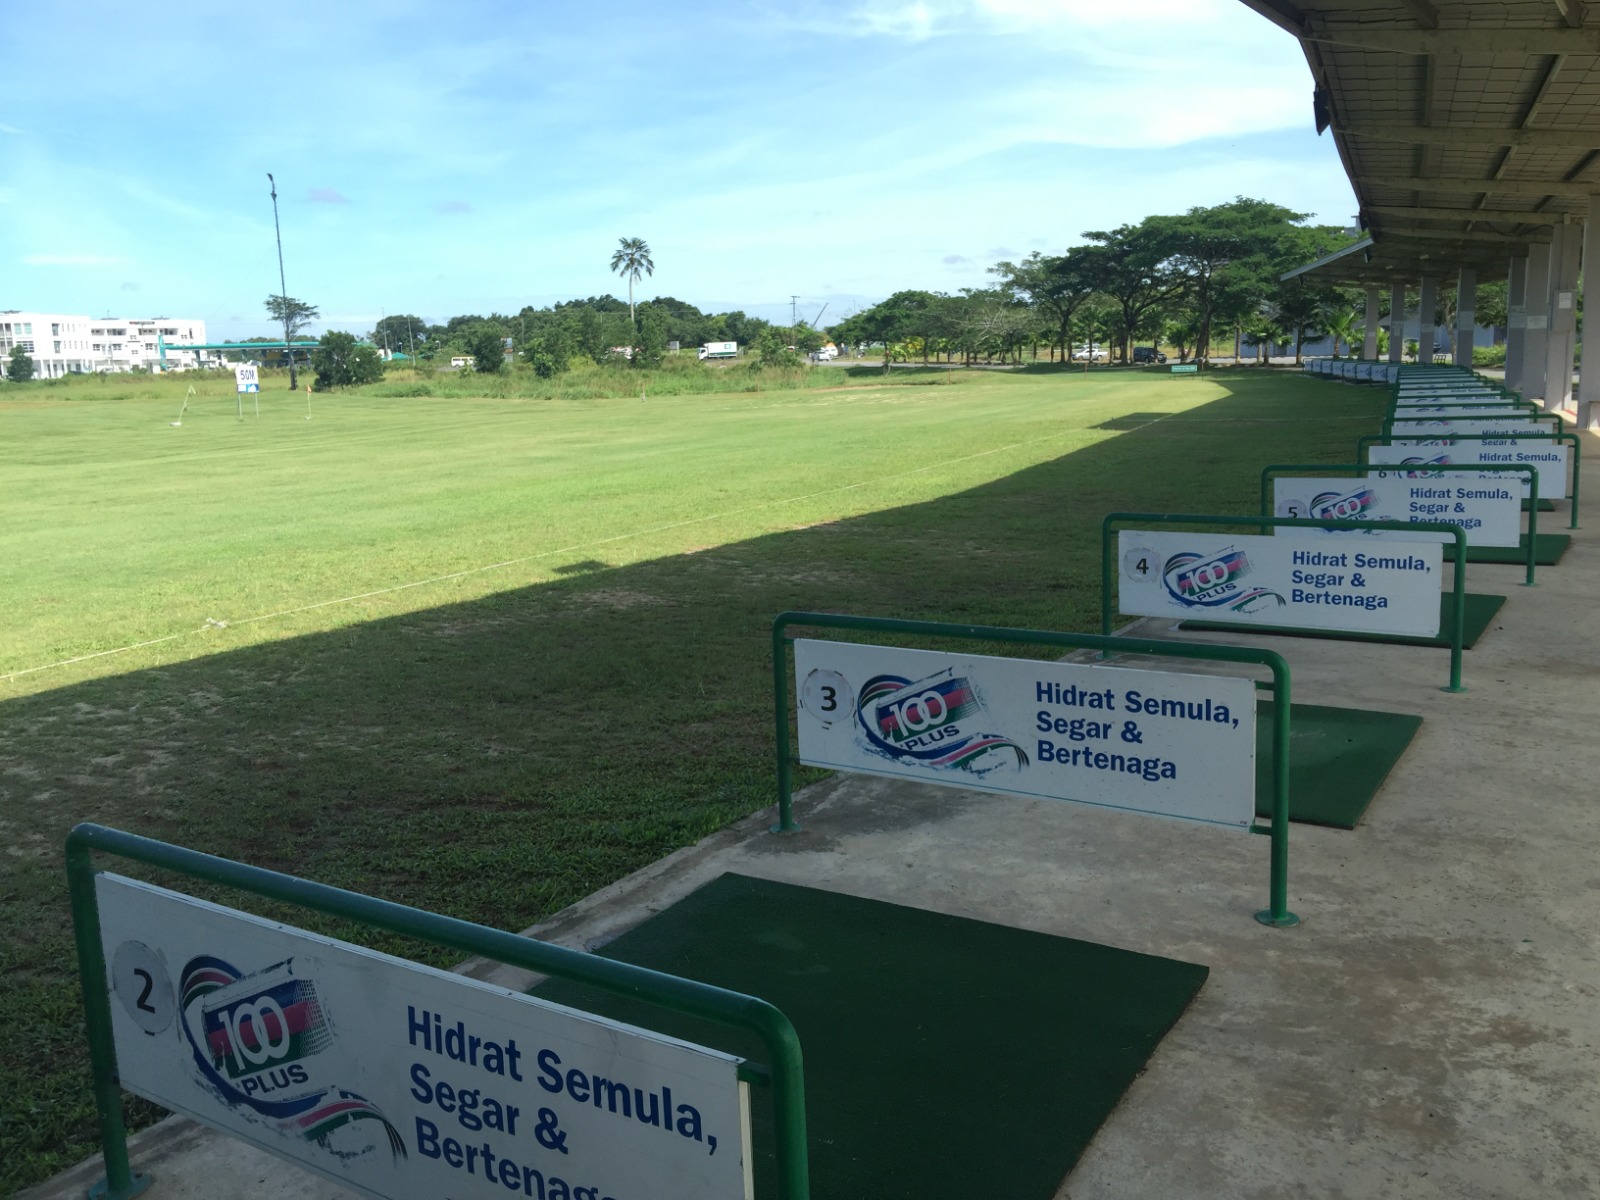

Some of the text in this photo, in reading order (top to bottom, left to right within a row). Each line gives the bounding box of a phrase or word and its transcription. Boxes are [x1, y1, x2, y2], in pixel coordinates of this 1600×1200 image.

[240, 369, 255, 380] 50M
[1479, 453, 1562, 462] Hidrat Semula,
[1410, 488, 1513, 501] Hidrat Semula,
[1288, 506, 1298, 518] 5
[1327, 497, 1361, 520] 100
[1409, 502, 1465, 515] Segar &
[1135, 558, 1149, 575] 4
[1292, 551, 1431, 574] Hidrat Semula,
[1186, 561, 1229, 594] 100
[1291, 570, 1366, 588] Segar &
[1196, 583, 1237, 601] PLUS
[1291, 588, 1388, 611] Bertenaga
[820, 686, 837, 712] 3
[1035, 681, 1239, 730] Hidrat Semula,
[889, 690, 948, 737] 100
[905, 724, 961, 750] PLUS
[1035, 710, 1143, 744] Segar &
[1037, 739, 1177, 782] Bertenaga
[133, 967, 156, 1015] 2
[218, 995, 291, 1071] 100
[240, 1063, 309, 1096] PLUS
[407, 1004, 718, 1156] Hidrat Semula,
[410, 1062, 569, 1155] Segar &
[414, 1115, 612, 1200] Bertena
